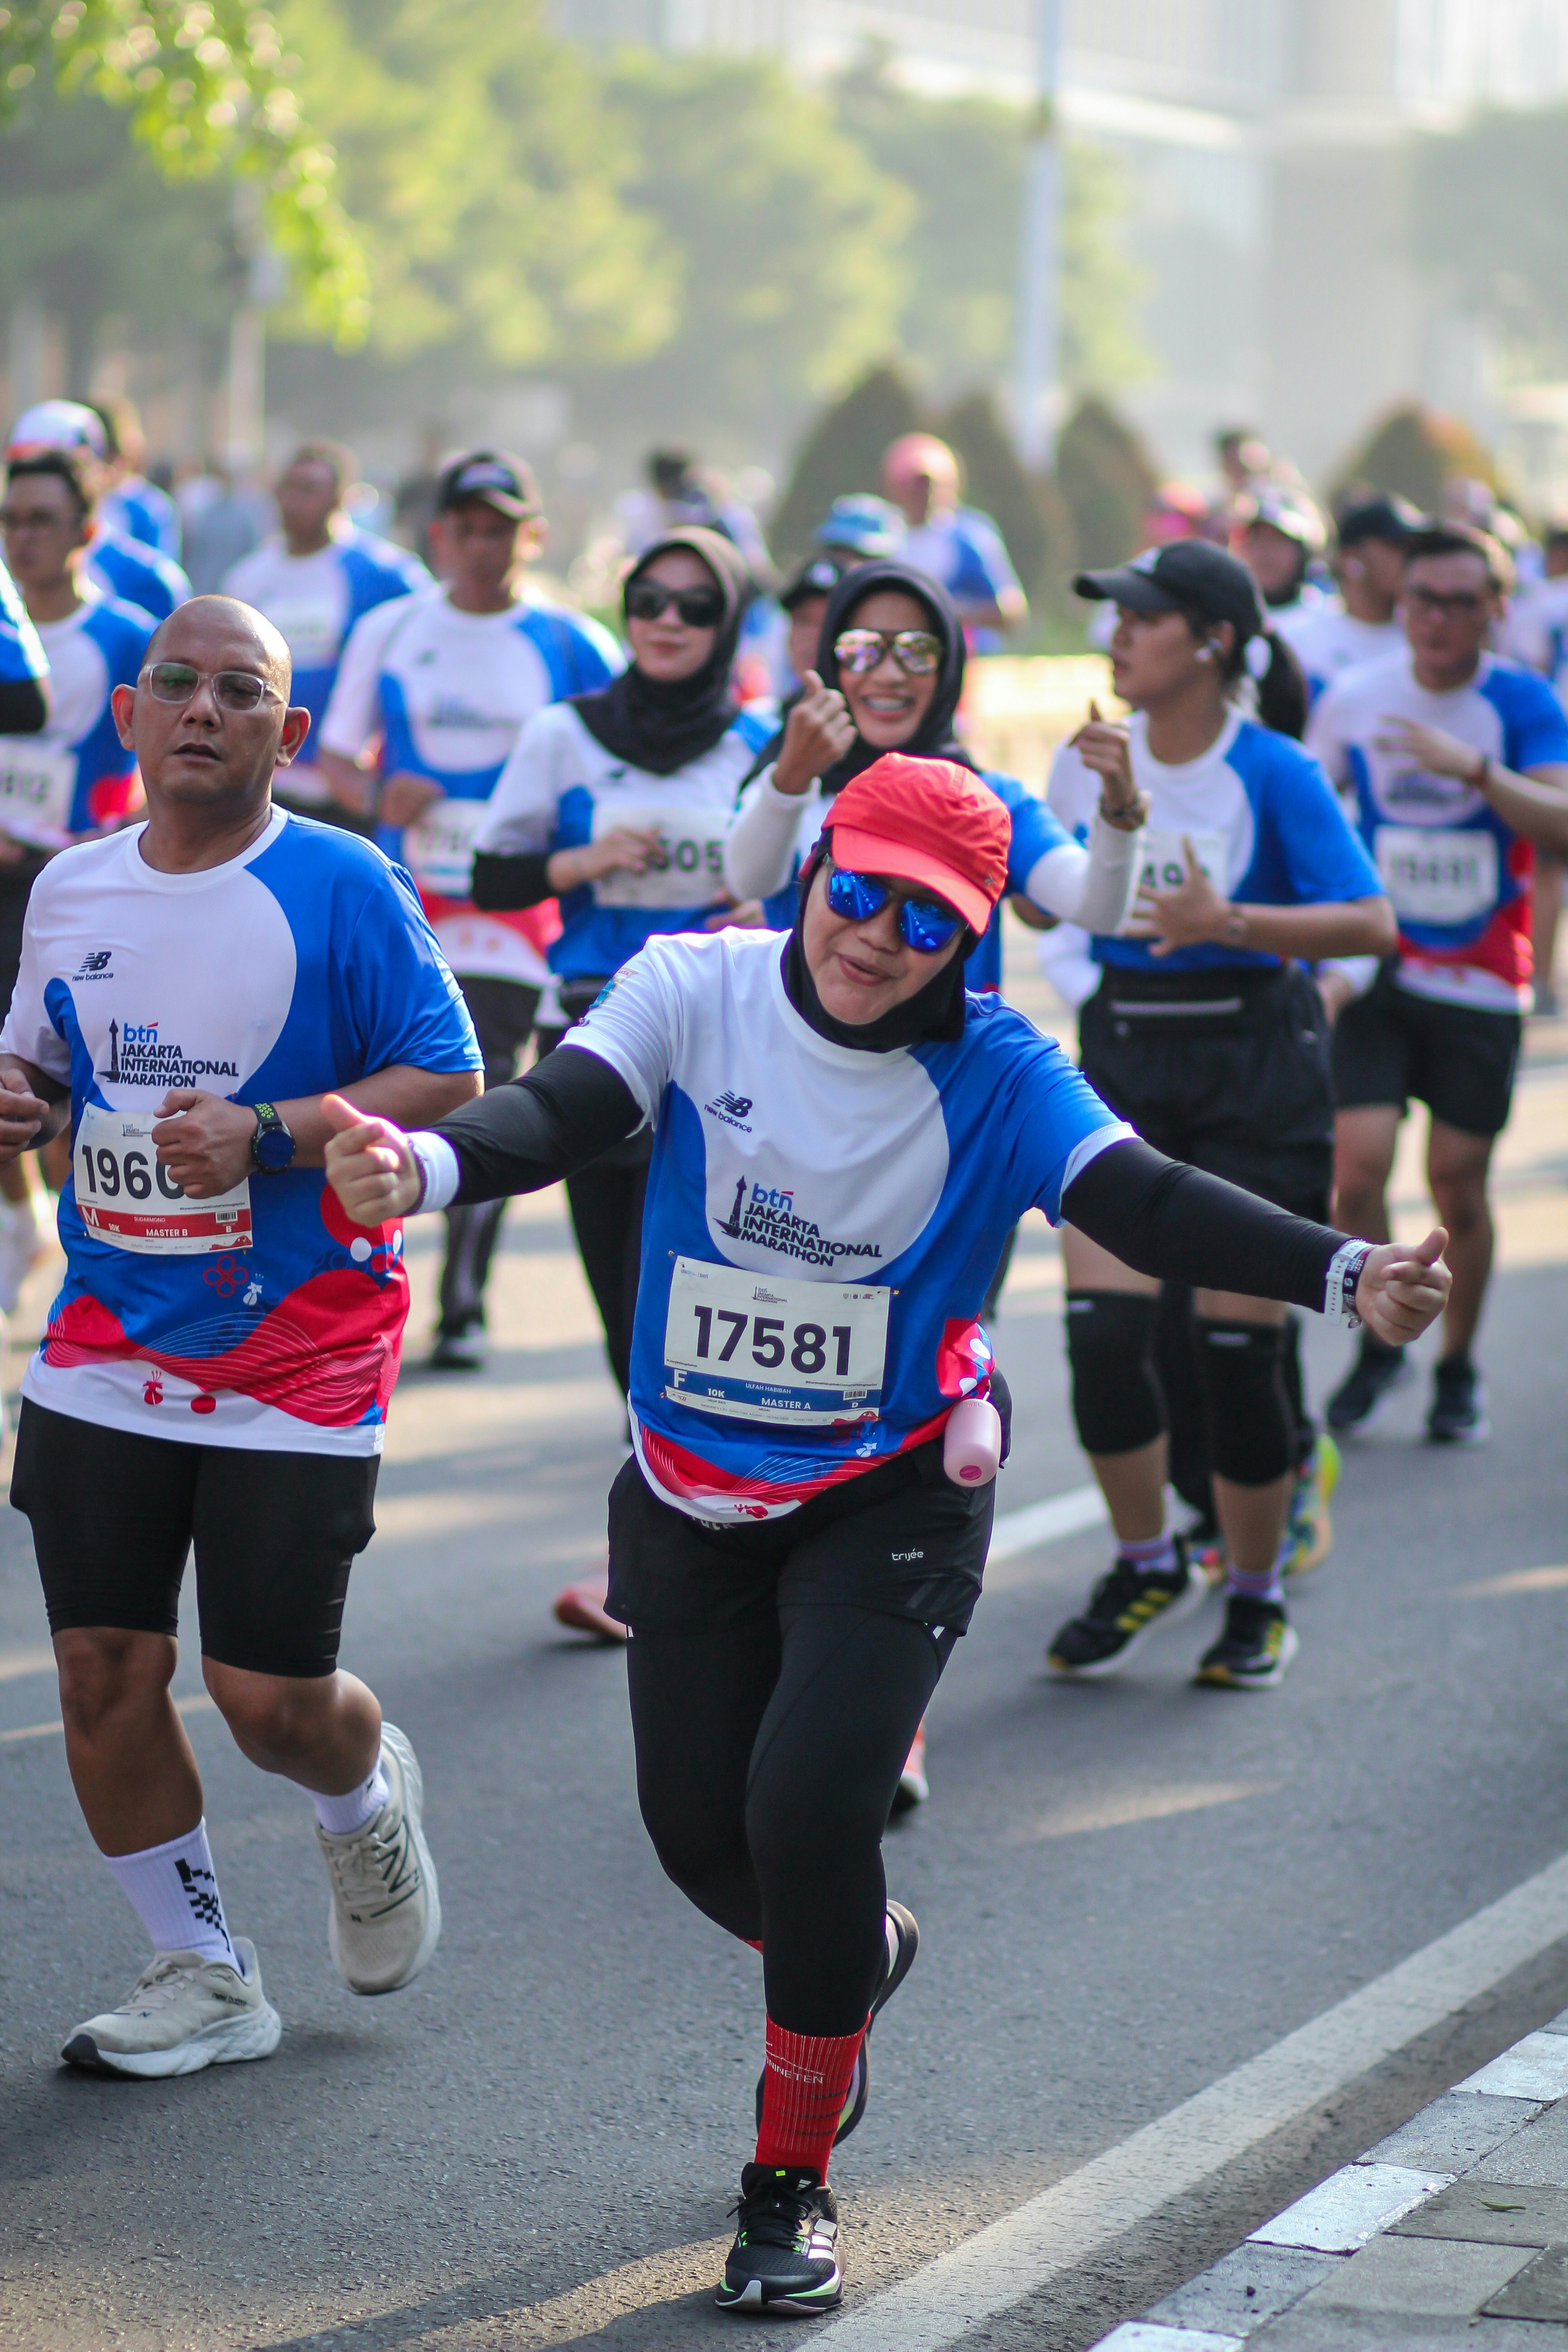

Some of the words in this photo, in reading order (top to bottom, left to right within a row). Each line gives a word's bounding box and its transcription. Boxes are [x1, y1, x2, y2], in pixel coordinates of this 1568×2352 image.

[121, 1044, 183, 1058] JAKARTA
[121, 1058, 239, 1077] INTERNATIONAL
[120, 1072, 196, 1088] MARATHON
[704, 1104, 718, 1116] new
[718, 1111, 752, 1132] balance
[81, 1205, 100, 1227] M
[745, 1203, 820, 1238] JAKARTA
[108, 1223, 120, 1232] 10K
[146, 1229, 180, 1237] MASTER
[743, 1215, 882, 1257] INTERNATIONAL
[741, 1229, 834, 1267] MARATHON
[694, 1305, 851, 1376] 17581
[674, 1369, 687, 1388] F
[707, 1388, 725, 1398] 10K
[765, 1386, 791, 1394] HABIBAH
[761, 1397, 801, 1409] MASTER
